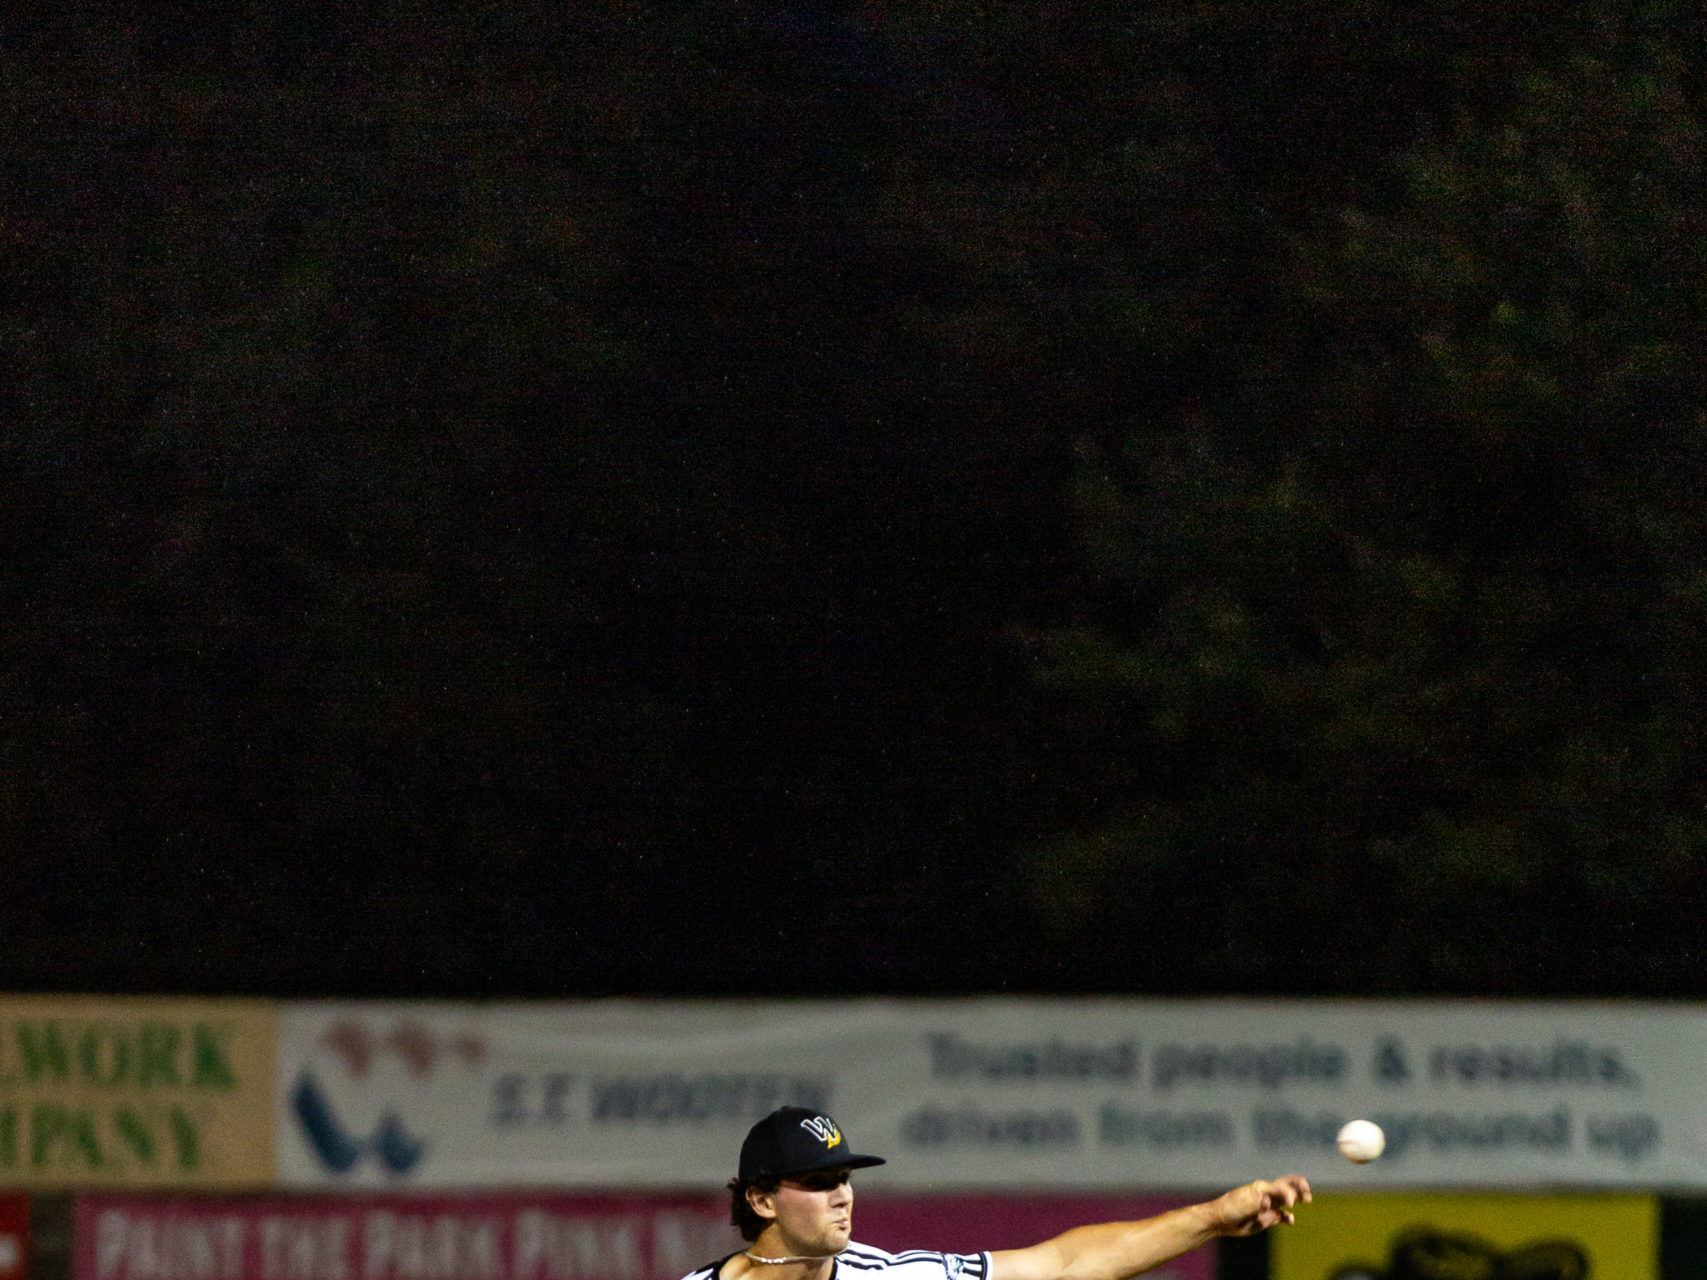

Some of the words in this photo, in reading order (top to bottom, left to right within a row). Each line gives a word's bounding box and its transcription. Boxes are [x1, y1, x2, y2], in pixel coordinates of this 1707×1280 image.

[926, 1032, 1140, 1084] Trusted
[1153, 1032, 1347, 1094] people
[902, 1104, 1080, 1150] driven
[1098, 1102, 1236, 1148] from
